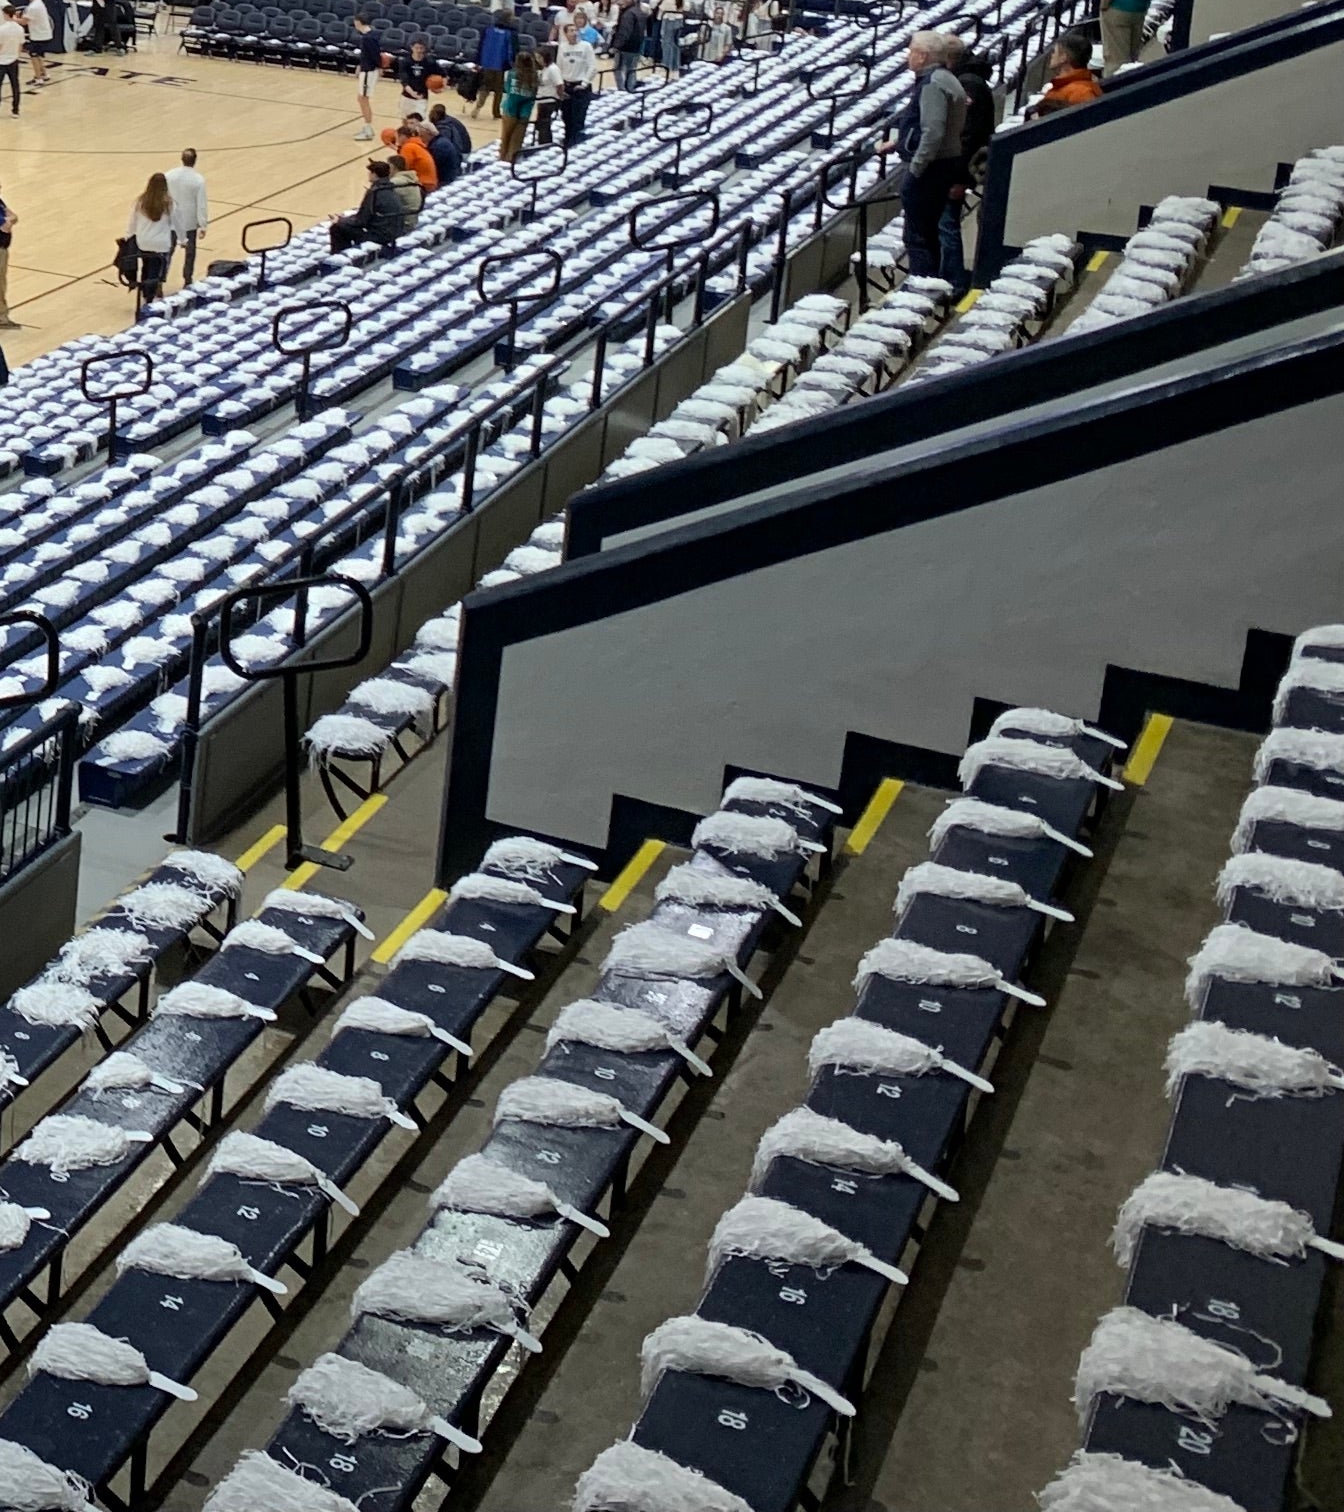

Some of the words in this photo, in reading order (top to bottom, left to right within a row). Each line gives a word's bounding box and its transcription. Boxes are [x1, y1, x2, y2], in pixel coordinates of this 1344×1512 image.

[956, 925, 977, 935] 8
[918, 1001, 942, 1013] 10
[1275, 994, 1302, 1010] 12
[370, 1050, 390, 1061] 8
[595, 1067, 615, 1080] 10
[876, 1083, 901, 1099] 12
[307, 1125, 329, 1138] 10
[831, 1179, 856, 1195] 14
[237, 1206, 261, 1220] 12
[161, 1294, 183, 1312] 14
[779, 1286, 806, 1305] 16
[1208, 1299, 1240, 1320] 18
[66, 1401, 92, 1421] 16
[717, 1410, 747, 1429] 18
[1178, 1427, 1213, 1455] 20
[329, 1454, 359, 1473] 18
